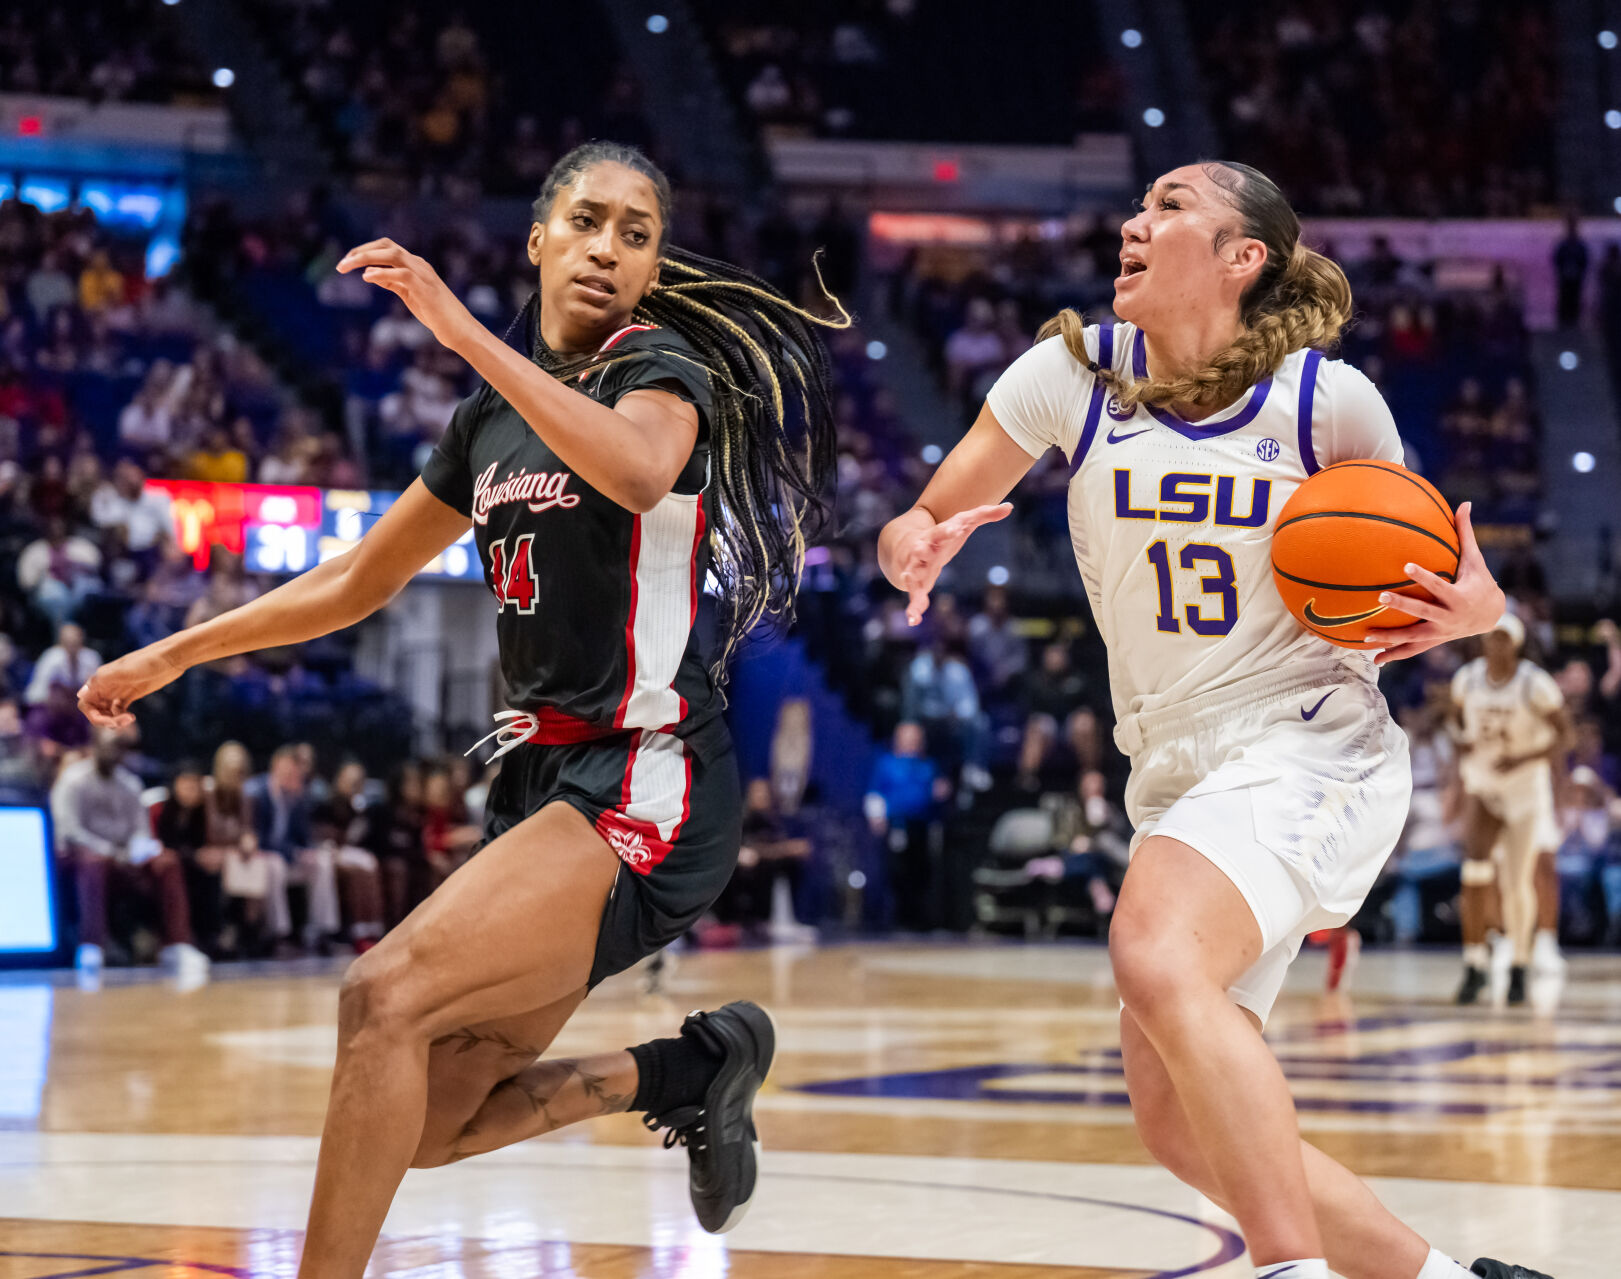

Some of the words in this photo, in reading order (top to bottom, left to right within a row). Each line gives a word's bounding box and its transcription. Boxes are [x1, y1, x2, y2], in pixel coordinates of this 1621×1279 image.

[1257, 438, 1279, 461] SEC
[471, 461, 580, 525] Louisiana
[1113, 468, 1272, 529] LSU
[1146, 539, 1240, 637] 13
